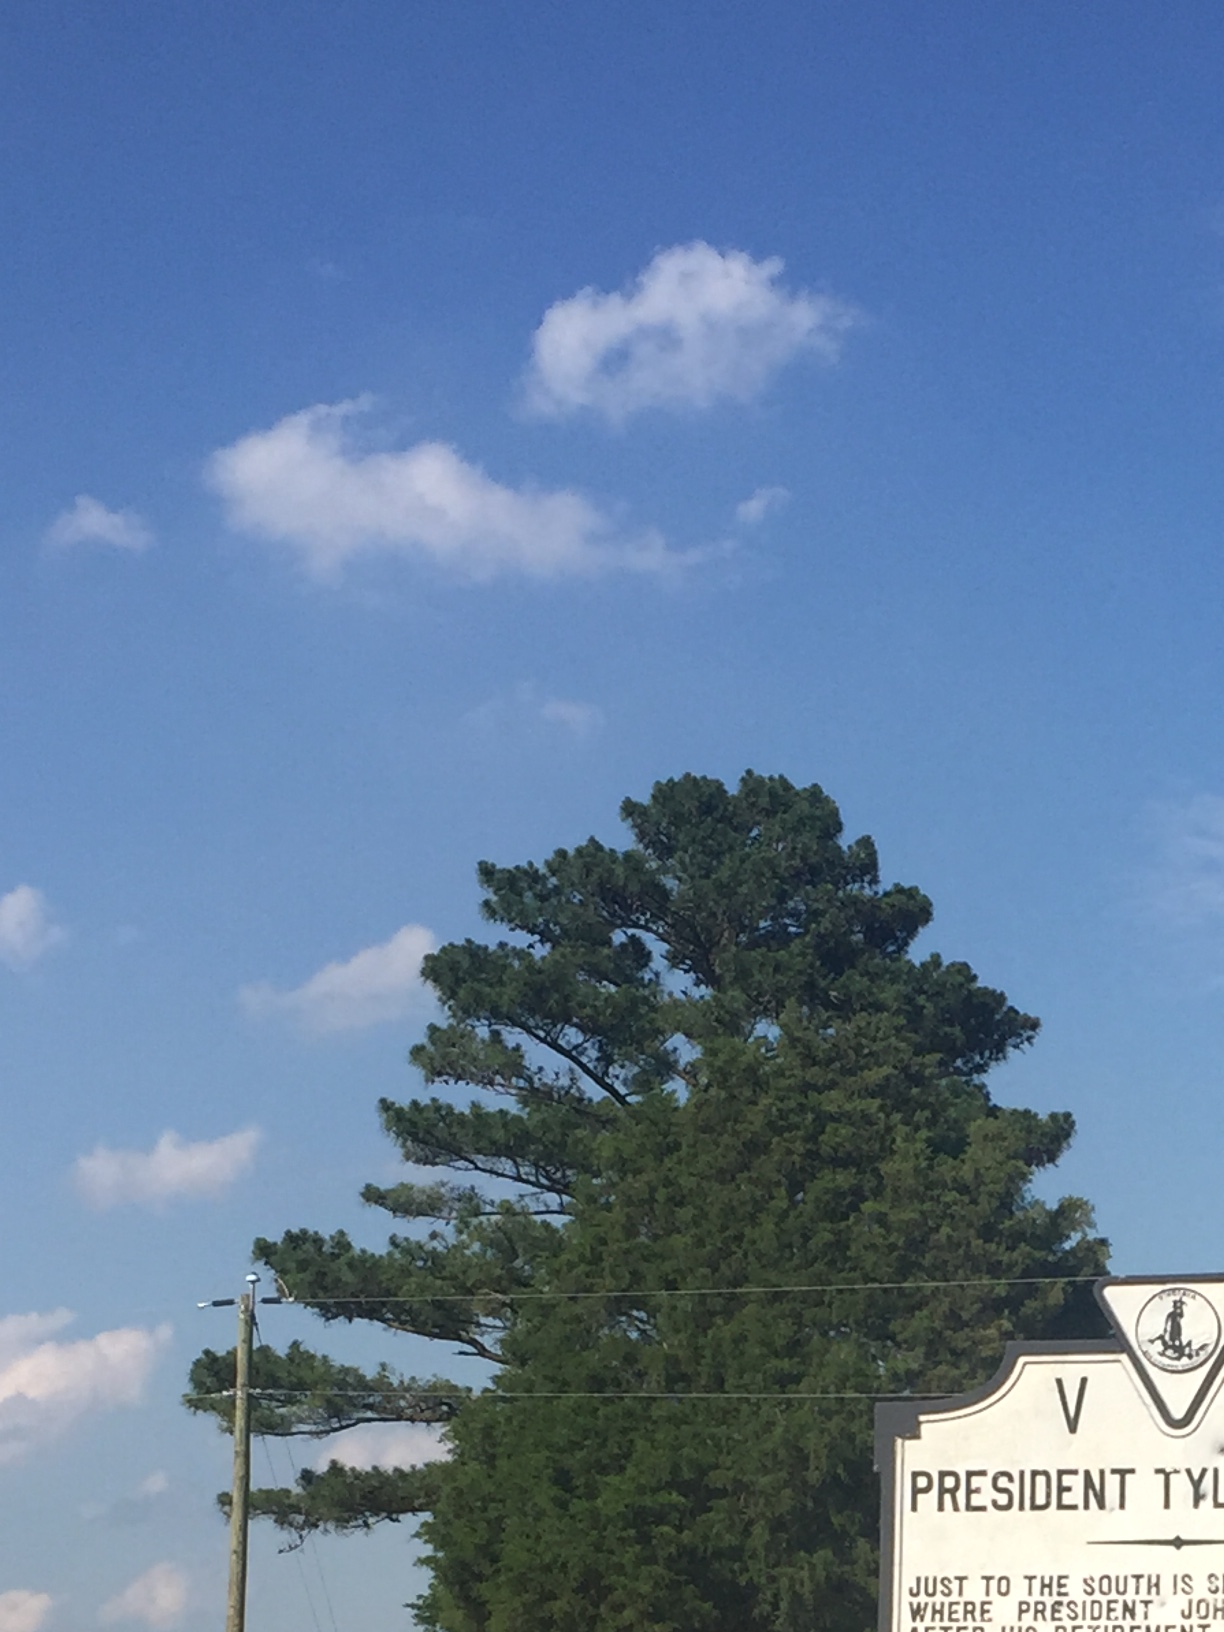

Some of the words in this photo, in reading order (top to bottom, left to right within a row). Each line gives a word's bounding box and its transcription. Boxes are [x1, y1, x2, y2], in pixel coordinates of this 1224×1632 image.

[1055, 1376, 1089, 1435] V
[910, 1467, 1136, 1512] PRESIDENT
[908, 1576, 969, 1599] JUST
[980, 1576, 1011, 1597] TO
[1023, 1576, 1070, 1597] THE
[1082, 1574, 1161, 1597] SOUTH
[1173, 1574, 1194, 1595] IS
[907, 1600, 993, 1624] WHERE
[1017, 1600, 1154, 1622] PRESIDENT
